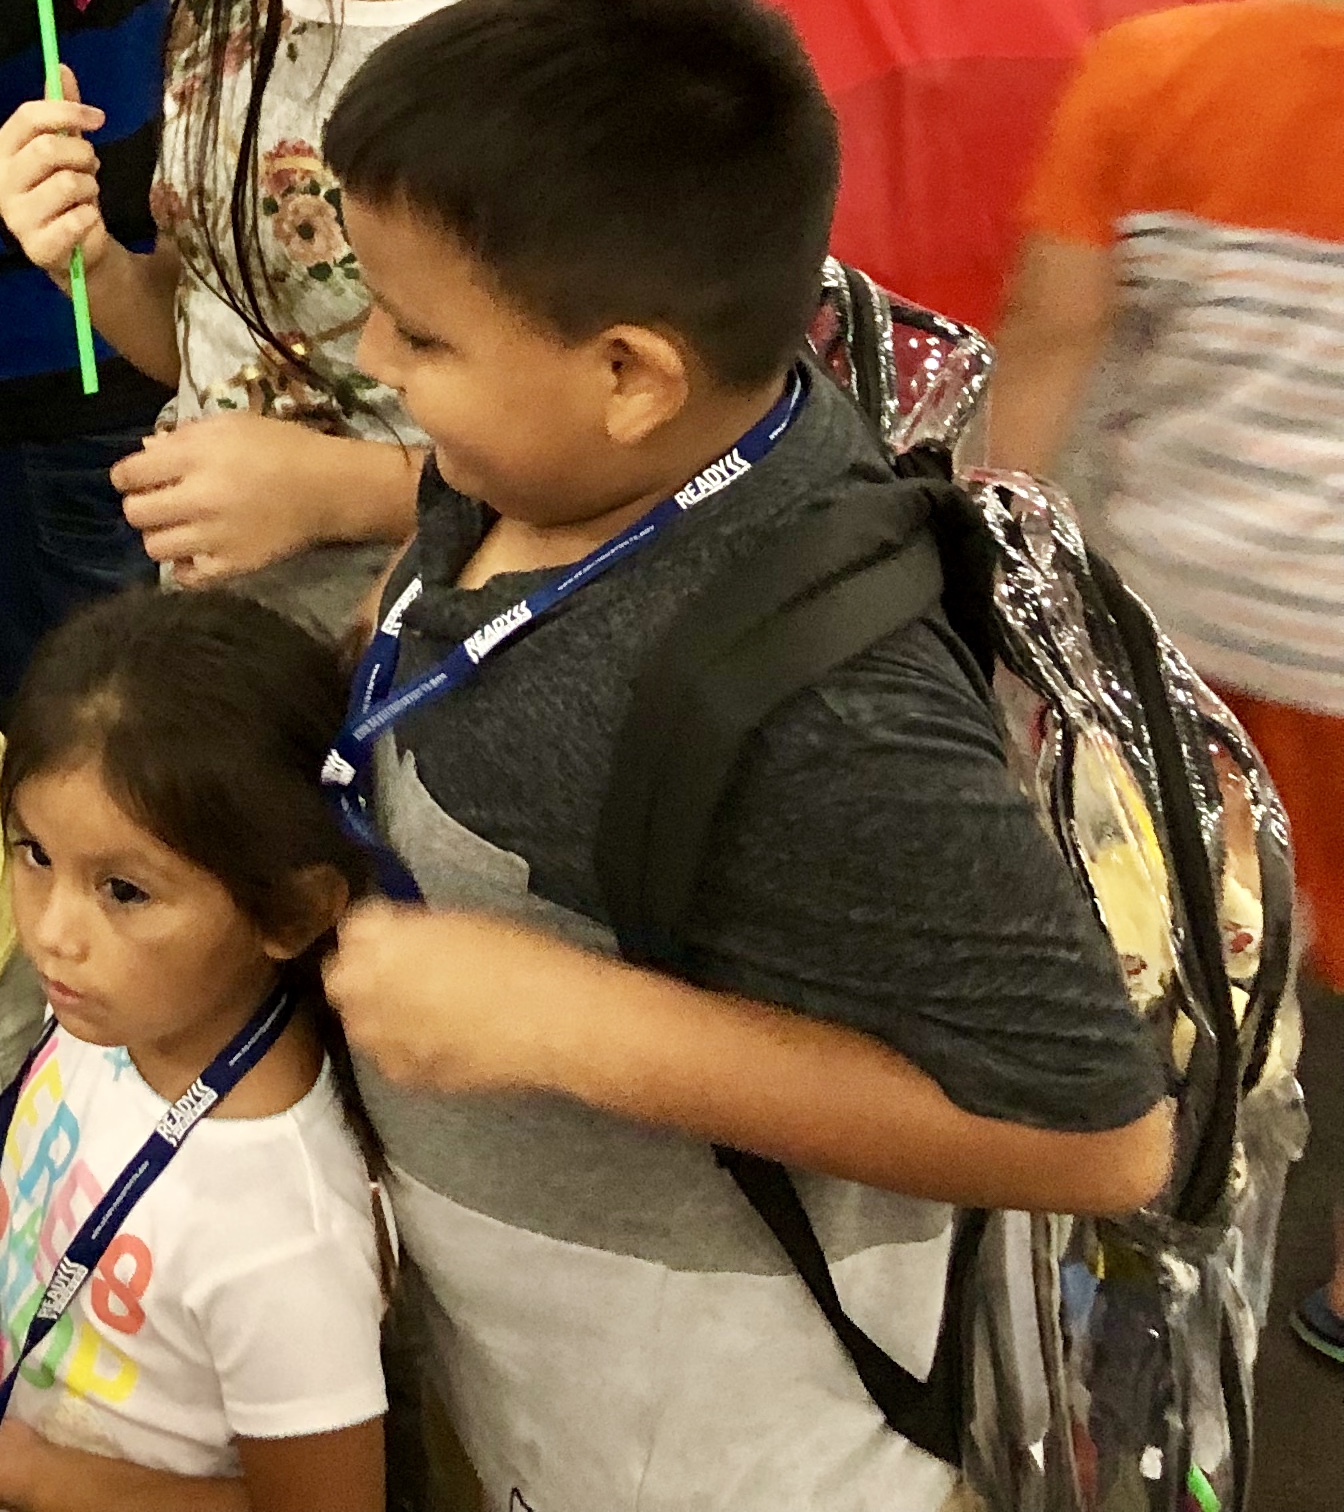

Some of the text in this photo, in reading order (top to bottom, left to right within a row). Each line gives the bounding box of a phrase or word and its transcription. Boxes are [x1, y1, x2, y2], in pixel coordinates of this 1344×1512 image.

[674, 461, 731, 510] READY
[465, 607, 516, 655] READY
[154, 1087, 200, 1139] READY
